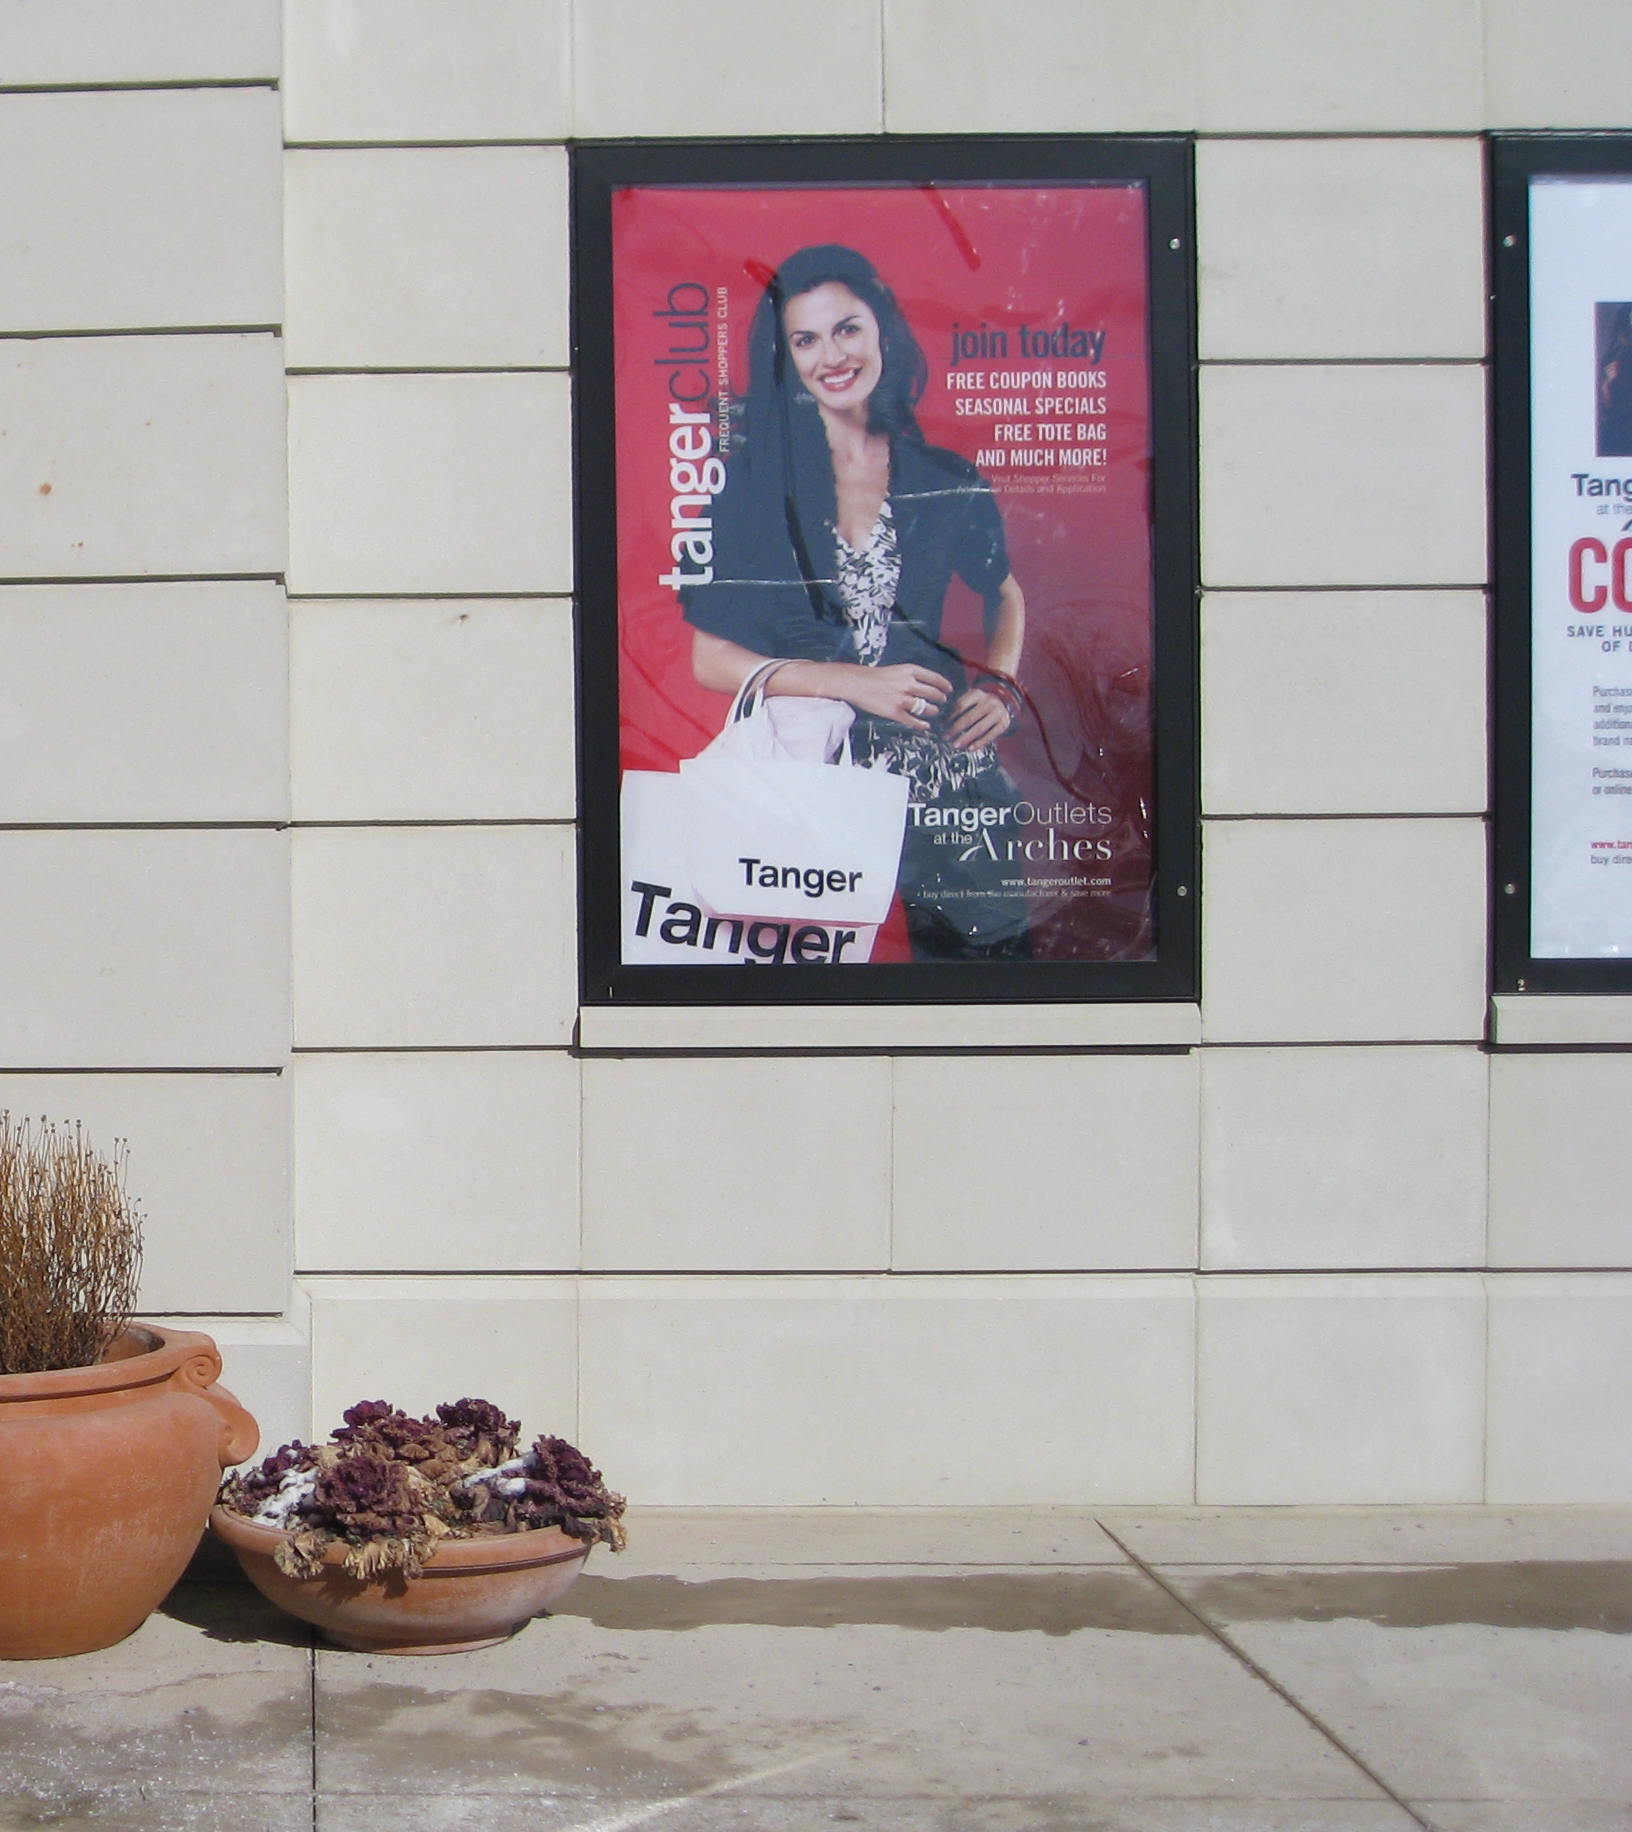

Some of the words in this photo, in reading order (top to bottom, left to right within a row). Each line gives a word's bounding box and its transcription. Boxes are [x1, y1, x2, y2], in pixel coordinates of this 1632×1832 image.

[718, 287, 728, 318] CLUB
[951, 323, 1008, 366] join
[1020, 322, 1106, 365] today
[718, 323, 729, 385] SHOPPERS
[946, 372, 985, 390] FREE
[990, 371, 1053, 389] COUPON
[1057, 371, 1107, 389] BOOKS
[955, 398, 1031, 416] SEASONAL
[1035, 397, 1107, 415] SPECIALS
[718, 389, 731, 453] FREQUENT
[994, 424, 1032, 441] FREE
[1037, 423, 1072, 441] TOTE
[1077, 423, 1107, 441] BAG
[975, 450, 1005, 467] AND
[1010, 449, 1054, 466] MUCH
[1059, 448, 1107, 466] MORE!
[1567, 625, 1604, 637] SAVE
[1601, 641, 1621, 652] OF
[934, 835, 947, 845] at
[950, 833, 973, 845] the
[959, 828, 1113, 862] Arches
[738, 858, 863, 898] Tanger
[1000, 877, 1112, 888] www.tangeroutlet.com
[631, 880, 856, 965] Tanger
